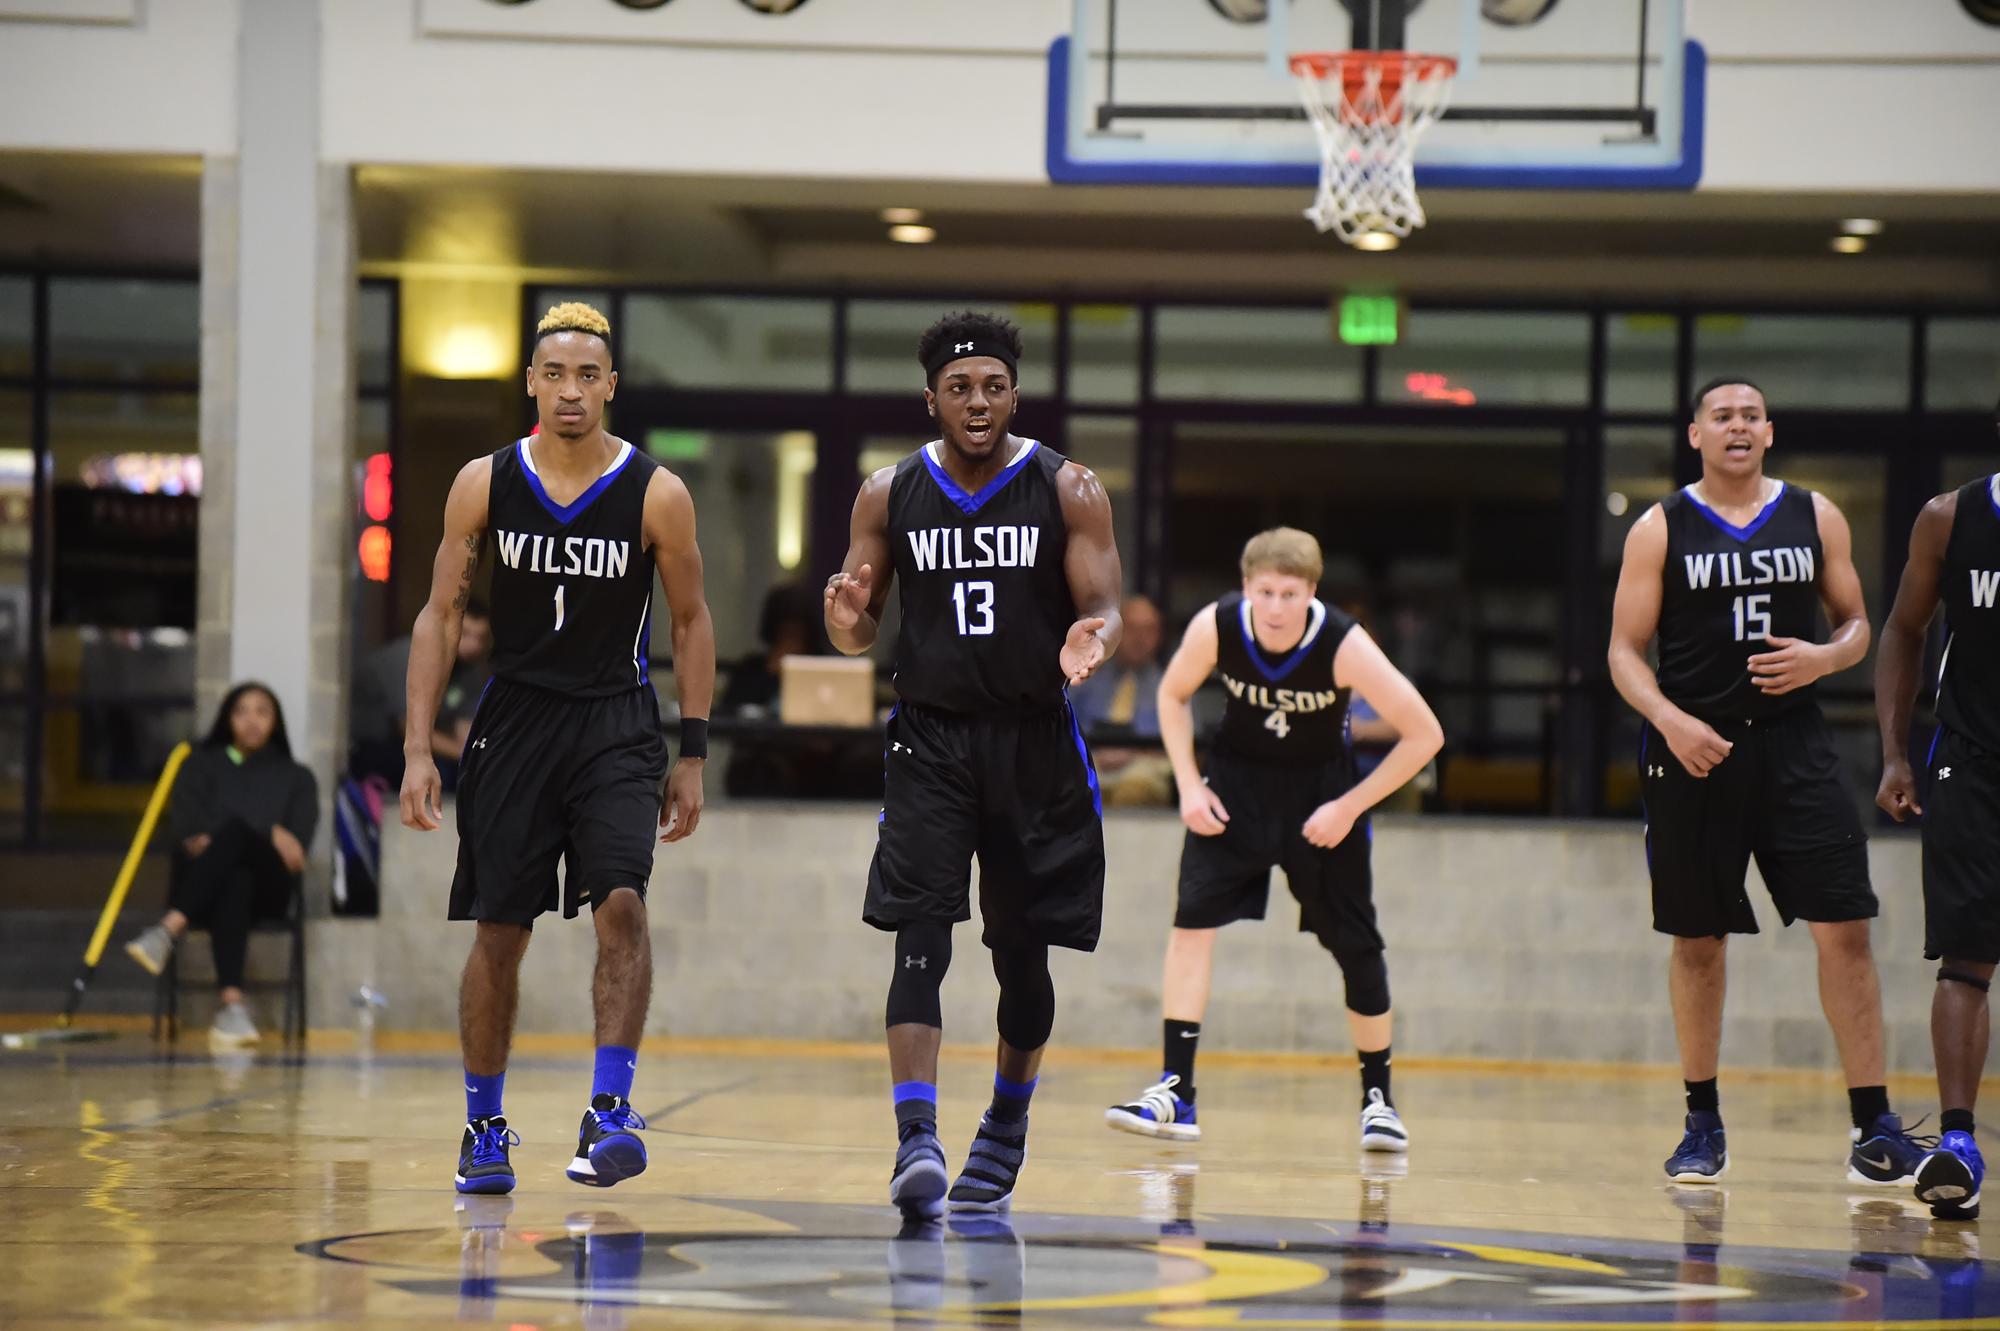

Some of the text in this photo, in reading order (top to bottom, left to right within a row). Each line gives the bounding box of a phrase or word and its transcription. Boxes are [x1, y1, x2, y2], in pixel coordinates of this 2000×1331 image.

[497, 529, 629, 578] WILSON
[907, 526, 1039, 571] WILSON
[1684, 547, 1815, 590] WILSON
[554, 585, 565, 631] 1
[952, 581, 994, 635] 13
[1732, 594, 1772, 641] 15
[1222, 673, 1336, 713] WILSON
[1264, 710, 1291, 738] 4
